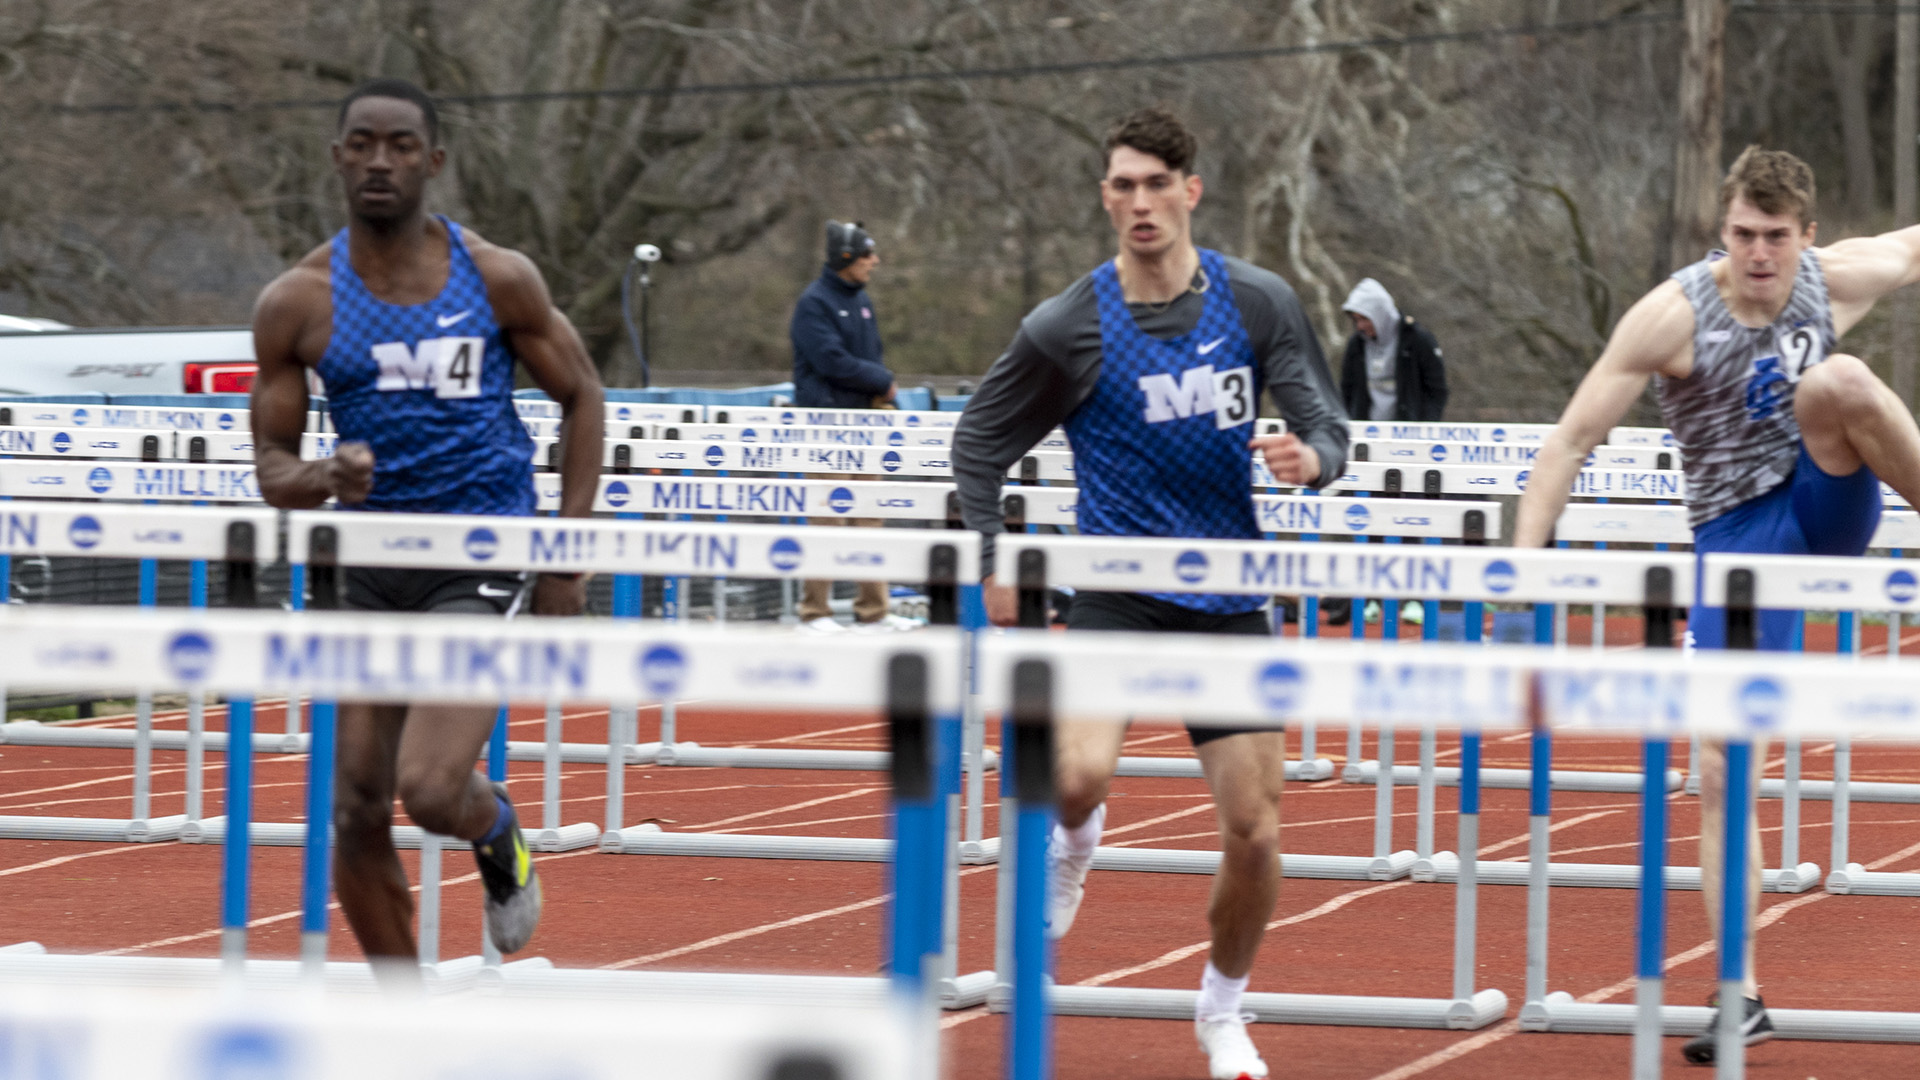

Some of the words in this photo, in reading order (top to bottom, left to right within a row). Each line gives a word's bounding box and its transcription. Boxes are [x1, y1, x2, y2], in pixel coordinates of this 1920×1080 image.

[447, 343, 471, 389] 4
[1223, 374, 1247, 422] 3
[102, 409, 205, 430] MILLIKIN
[1391, 426, 1480, 442] MILLIKIN
[656, 452, 688, 460] UCS
[742, 447, 865, 471] MILIKIN
[1461, 446, 1540, 465] MILLIK
[134, 468, 260, 497] MILLIK
[1466, 477, 1498, 485] UCS
[1570, 471, 1679, 496] ILLIKIN
[653, 482, 807, 512] MILLIKIN
[876, 498, 915, 508] UCS
[1393, 516, 1431, 526] UCS
[1240, 552, 1452, 591] MILLIKIN
[264, 634, 590, 688] MILLIKIN
